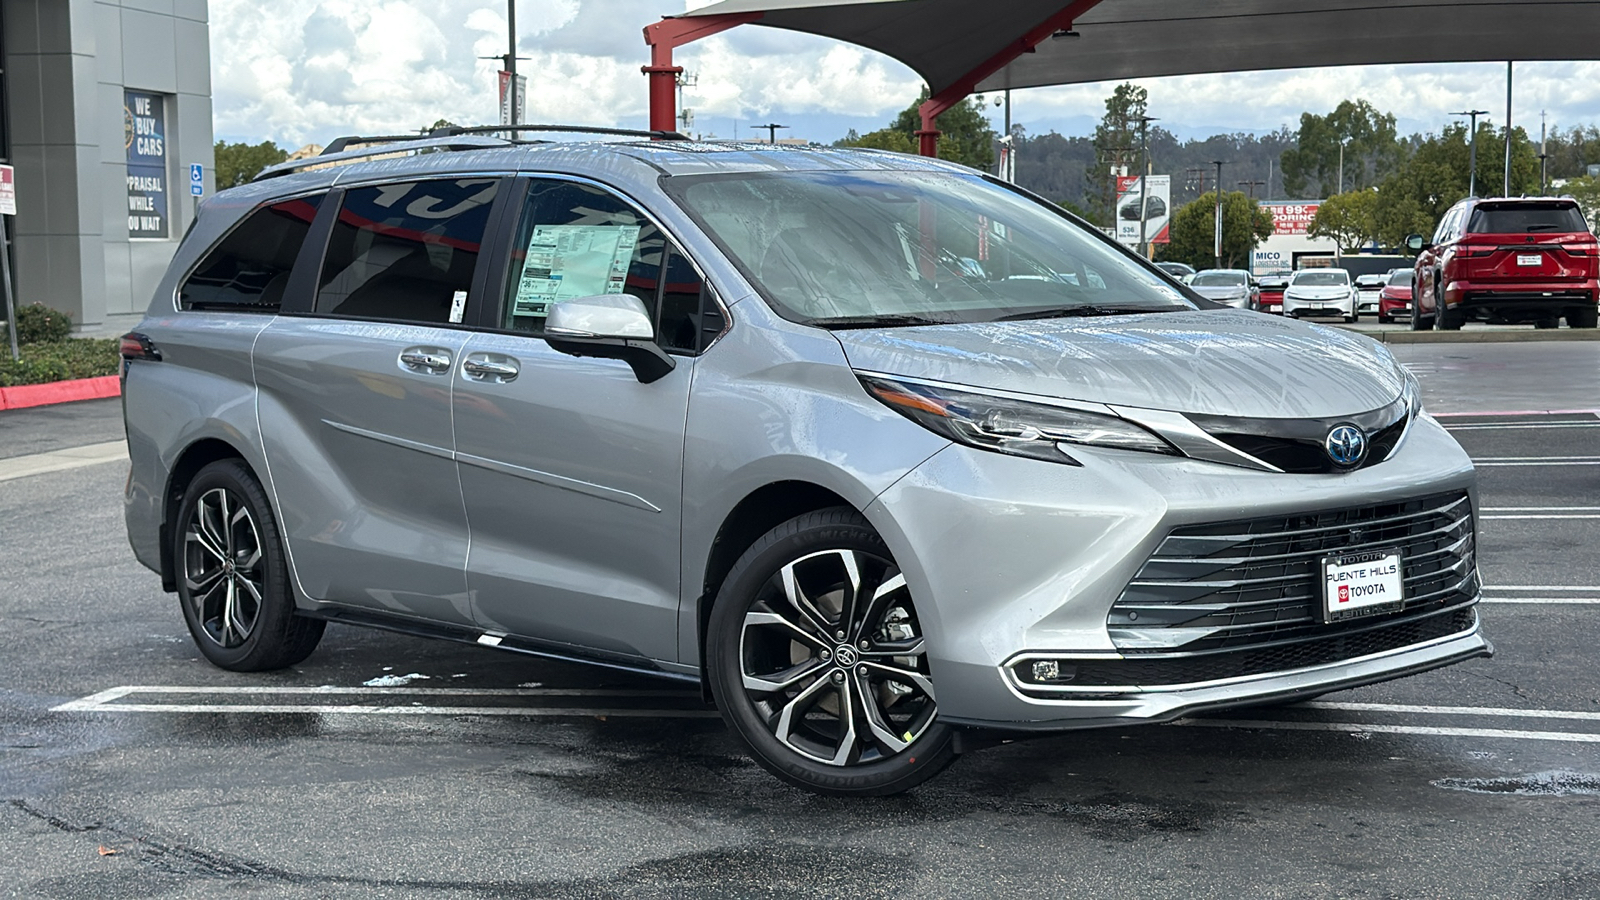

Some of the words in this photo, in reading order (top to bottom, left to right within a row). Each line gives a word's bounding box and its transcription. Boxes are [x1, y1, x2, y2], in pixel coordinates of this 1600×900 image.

[135, 97, 150, 116] WE
[136, 117, 156, 136] BUY
[137, 138, 163, 156] CARS
[126, 175, 162, 192] PRAISAL
[129, 196, 154, 211] WHILE
[128, 216, 139, 231] OU
[141, 216, 161, 231] WAIT
[1256, 252, 1280, 260] MICO
[1342, 552, 1382, 565] TOYOTA
[1327, 569, 1366, 583] PUENTE
[1370, 565, 1396, 577] HILLS
[1350, 583, 1385, 598] TOYOTA
